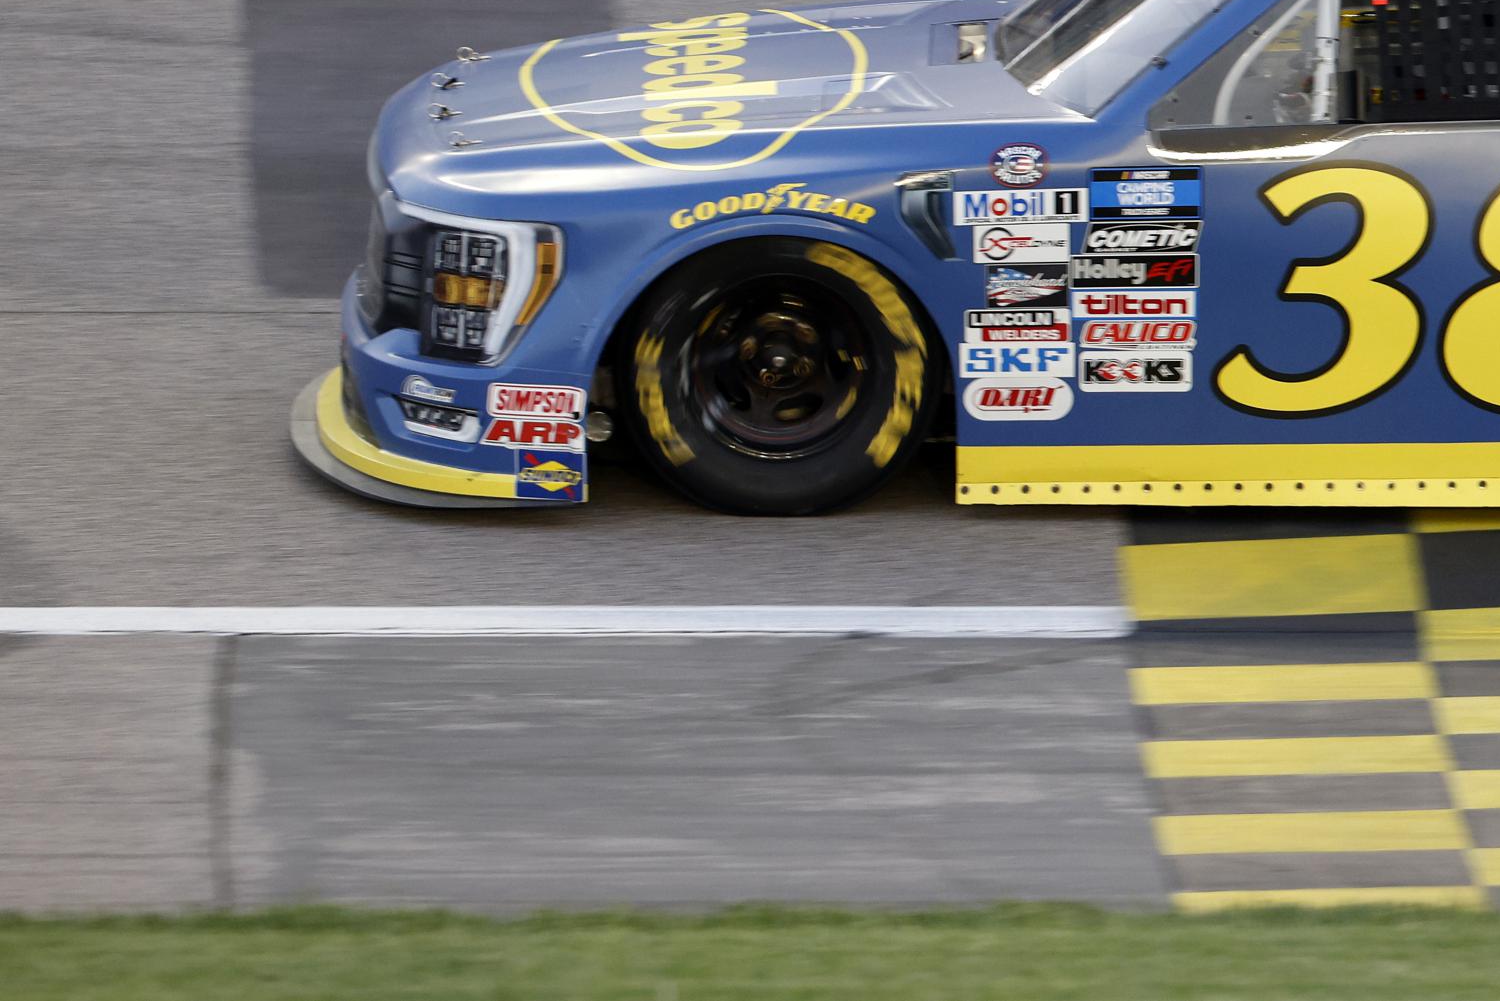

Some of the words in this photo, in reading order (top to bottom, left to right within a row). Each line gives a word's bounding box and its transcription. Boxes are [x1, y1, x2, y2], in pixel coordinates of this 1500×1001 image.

[617, 11, 778, 149] speedco
[669, 187, 877, 230] GOODYEAR
[964, 192, 1045, 217] Mobil
[1059, 193, 1073, 214] 1
[1087, 228, 1199, 248] COMETIC
[1073, 258, 1148, 285] Holley
[1080, 294, 1188, 315] tilton
[970, 312, 1053, 326] LINCOLN
[988, 328, 1062, 340] WELDERS
[1085, 322, 1193, 342] CALICO
[966, 347, 1070, 372] SKF
[1083, 359, 1185, 384] KOOKS
[496, 388, 575, 414] SIMPSON
[486, 420, 581, 444] ARP
